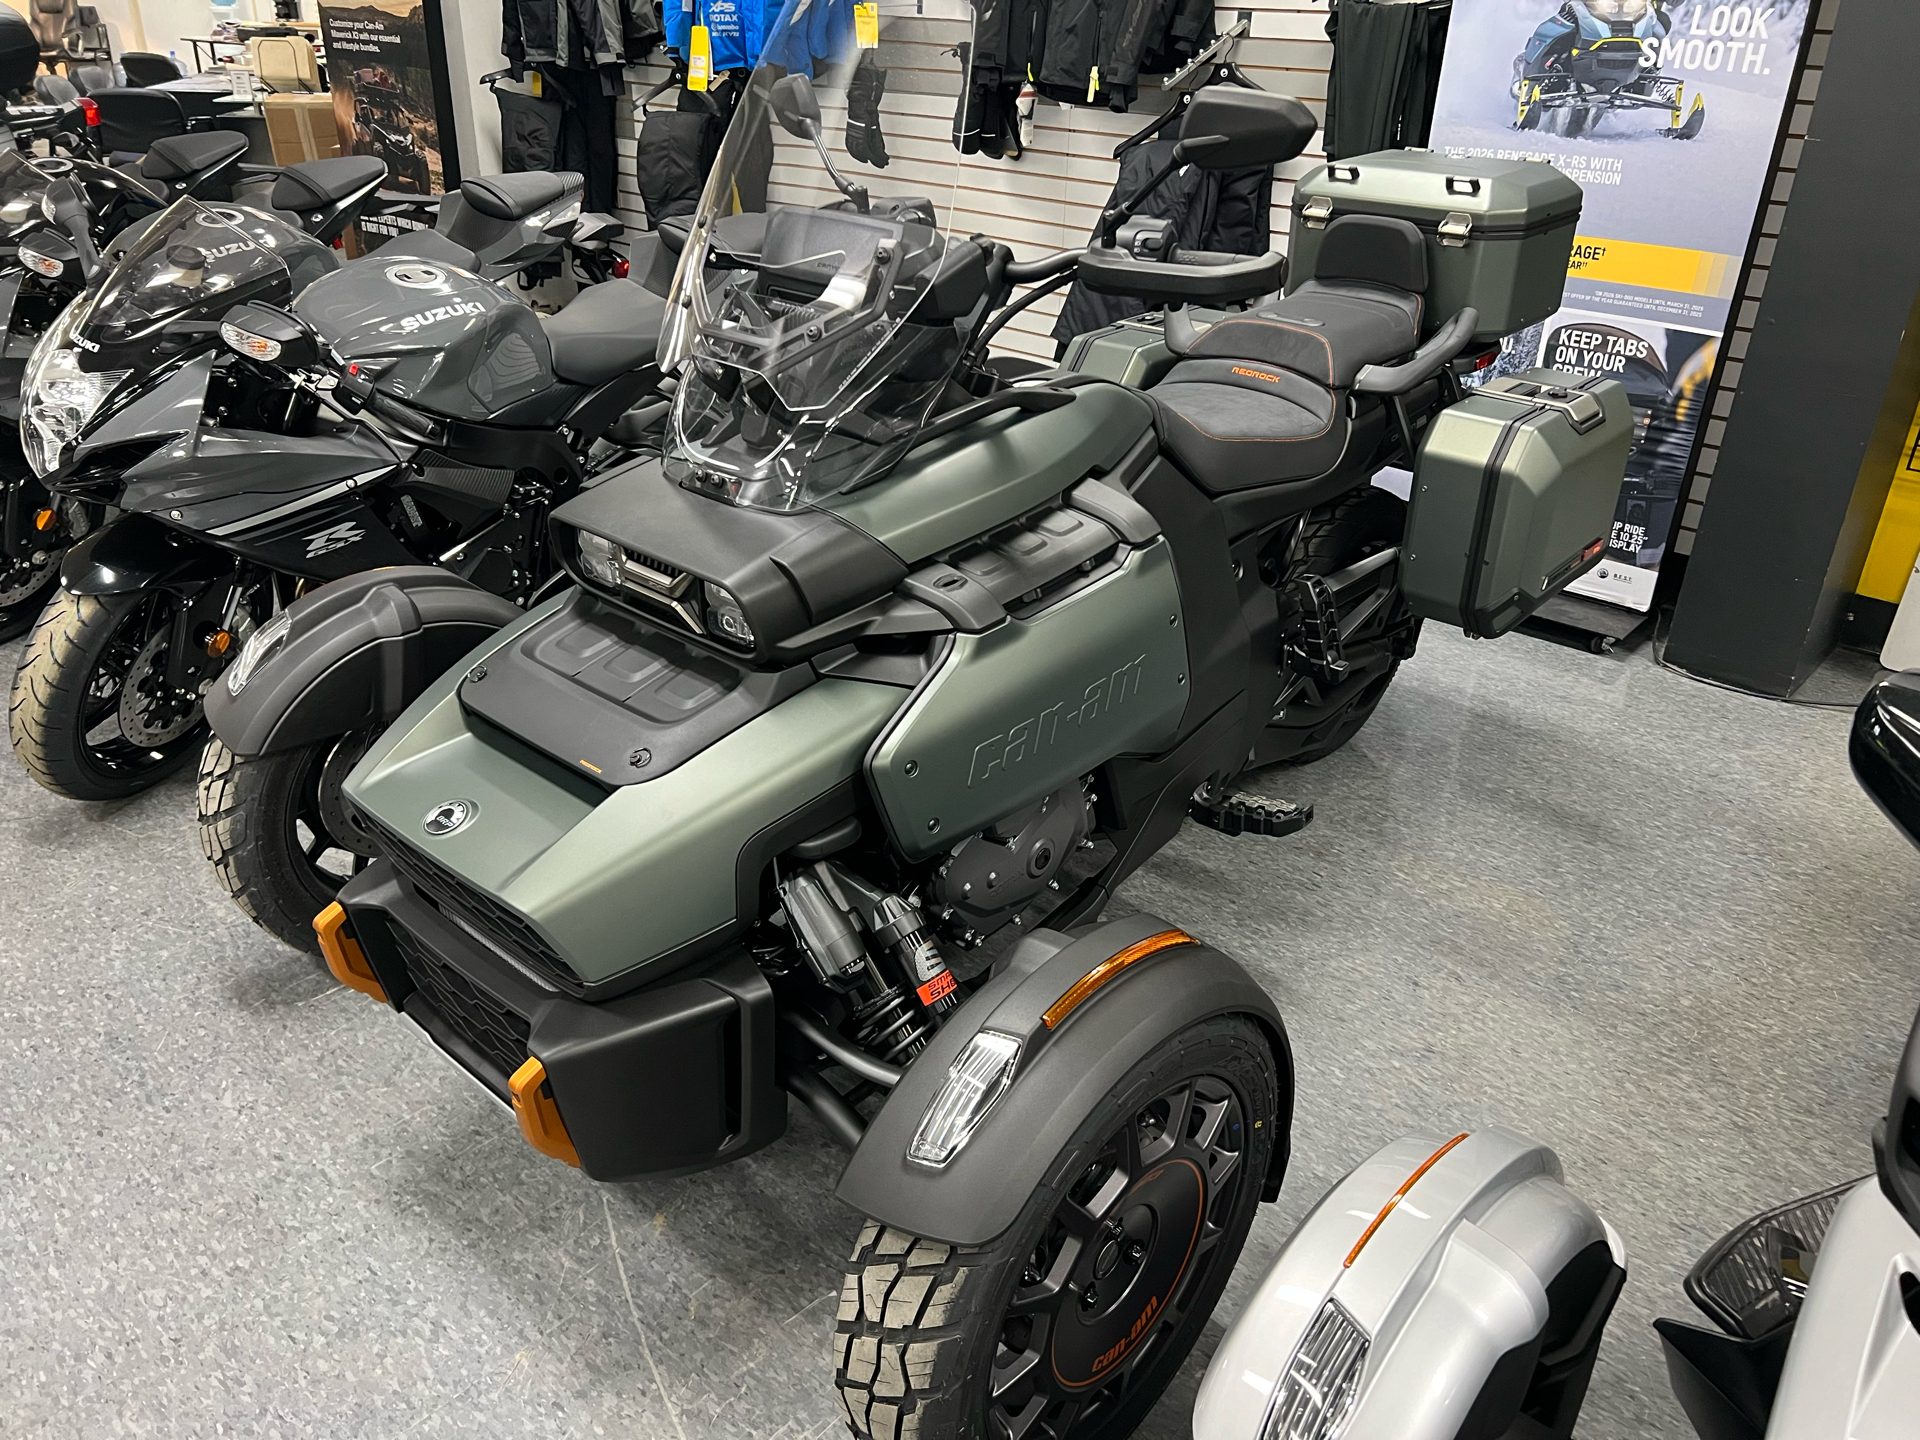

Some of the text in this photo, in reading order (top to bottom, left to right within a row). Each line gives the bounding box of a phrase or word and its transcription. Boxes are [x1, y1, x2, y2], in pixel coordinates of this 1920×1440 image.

[329, 18, 384, 30] Customize your Can-Am
[1689, 4, 1775, 39] LOOK
[331, 30, 351, 38] Maverick
[352, 31, 359, 39] X3
[359, 32, 369, 40] with
[379, 34, 401, 43] essential
[333, 41, 380, 53] and lifestyle bundles.
[1639, 37, 1770, 75] SMOOTH.
[1557, 154, 1587, 168] X-RS
[1591, 157, 1622, 171] WITH
[366, 222, 379, 233] RIGHT
[379, 224, 388, 235] FOR
[1613, 299, 1643, 309] GUARANTEED
[1643, 303, 1656, 311] UNTIL
[1657, 305, 1682, 315] DECEMBER
[400, 302, 486, 331] SUZUKI
[1558, 328, 1649, 359] KEEP TABS
[1555, 346, 1626, 373] ON YOUR
[1231, 366, 1281, 383] REDROCK
[1624, 523, 1646, 536] RIDE
[968, 653, 1147, 790] can-am
[436, 815, 454, 827] BRP
[1091, 1295, 1158, 1373] can-am
